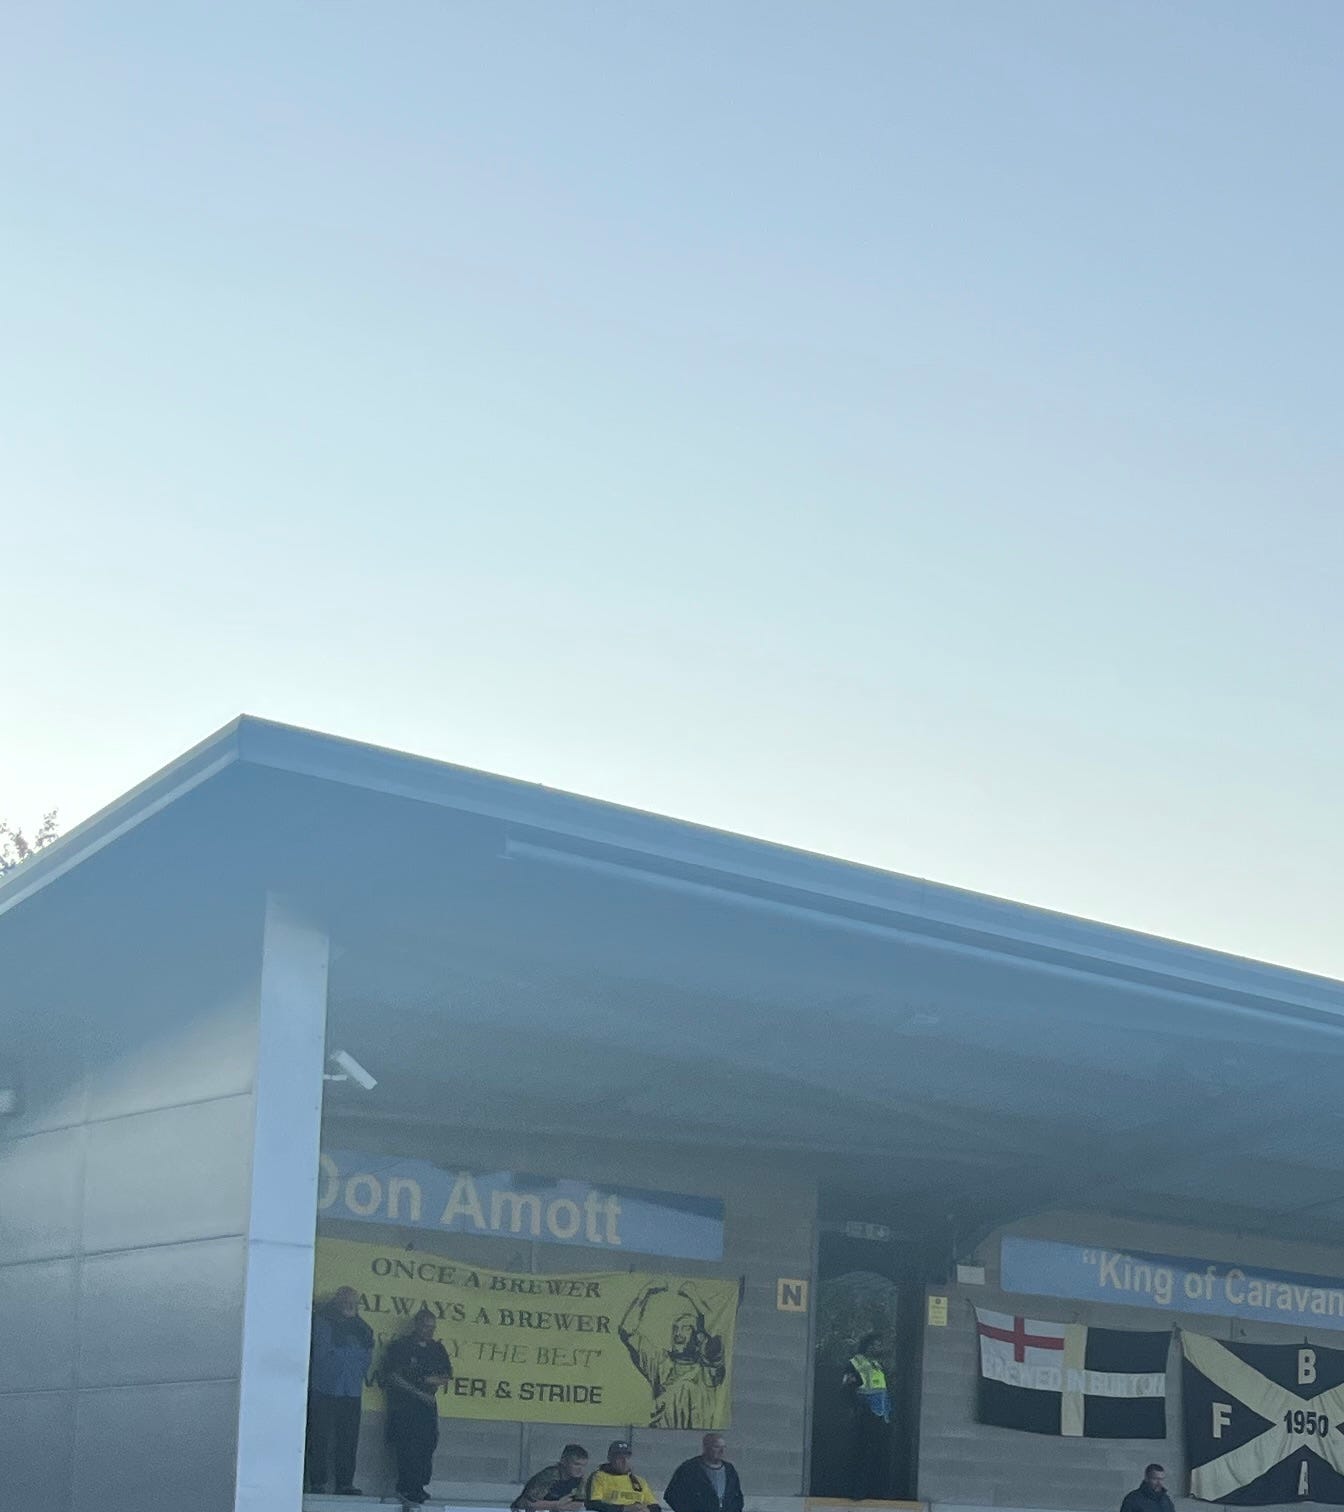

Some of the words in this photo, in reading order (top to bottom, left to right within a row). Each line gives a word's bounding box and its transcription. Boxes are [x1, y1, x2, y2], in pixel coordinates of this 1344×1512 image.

[371, 1256, 457, 1284] ONCE
[464, 1271, 488, 1289] A
[489, 1276, 602, 1299] BREWER
[781, 1281, 803, 1306] N
[1185, 1266, 1216, 1300] of
[355, 1293, 466, 1321] ALWAYS
[471, 1307, 491, 1325] A
[498, 1309, 612, 1335] BREWER
[471, 1341, 529, 1365] THE
[536, 1347, 602, 1369] BEST
[1298, 1349, 1317, 1385] B
[495, 1381, 513, 1400] &
[518, 1382, 603, 1405] STRIDE
[1212, 1403, 1233, 1439] F
[1283, 1409, 1330, 1438] 1950
[1298, 1461, 1310, 1495] A
